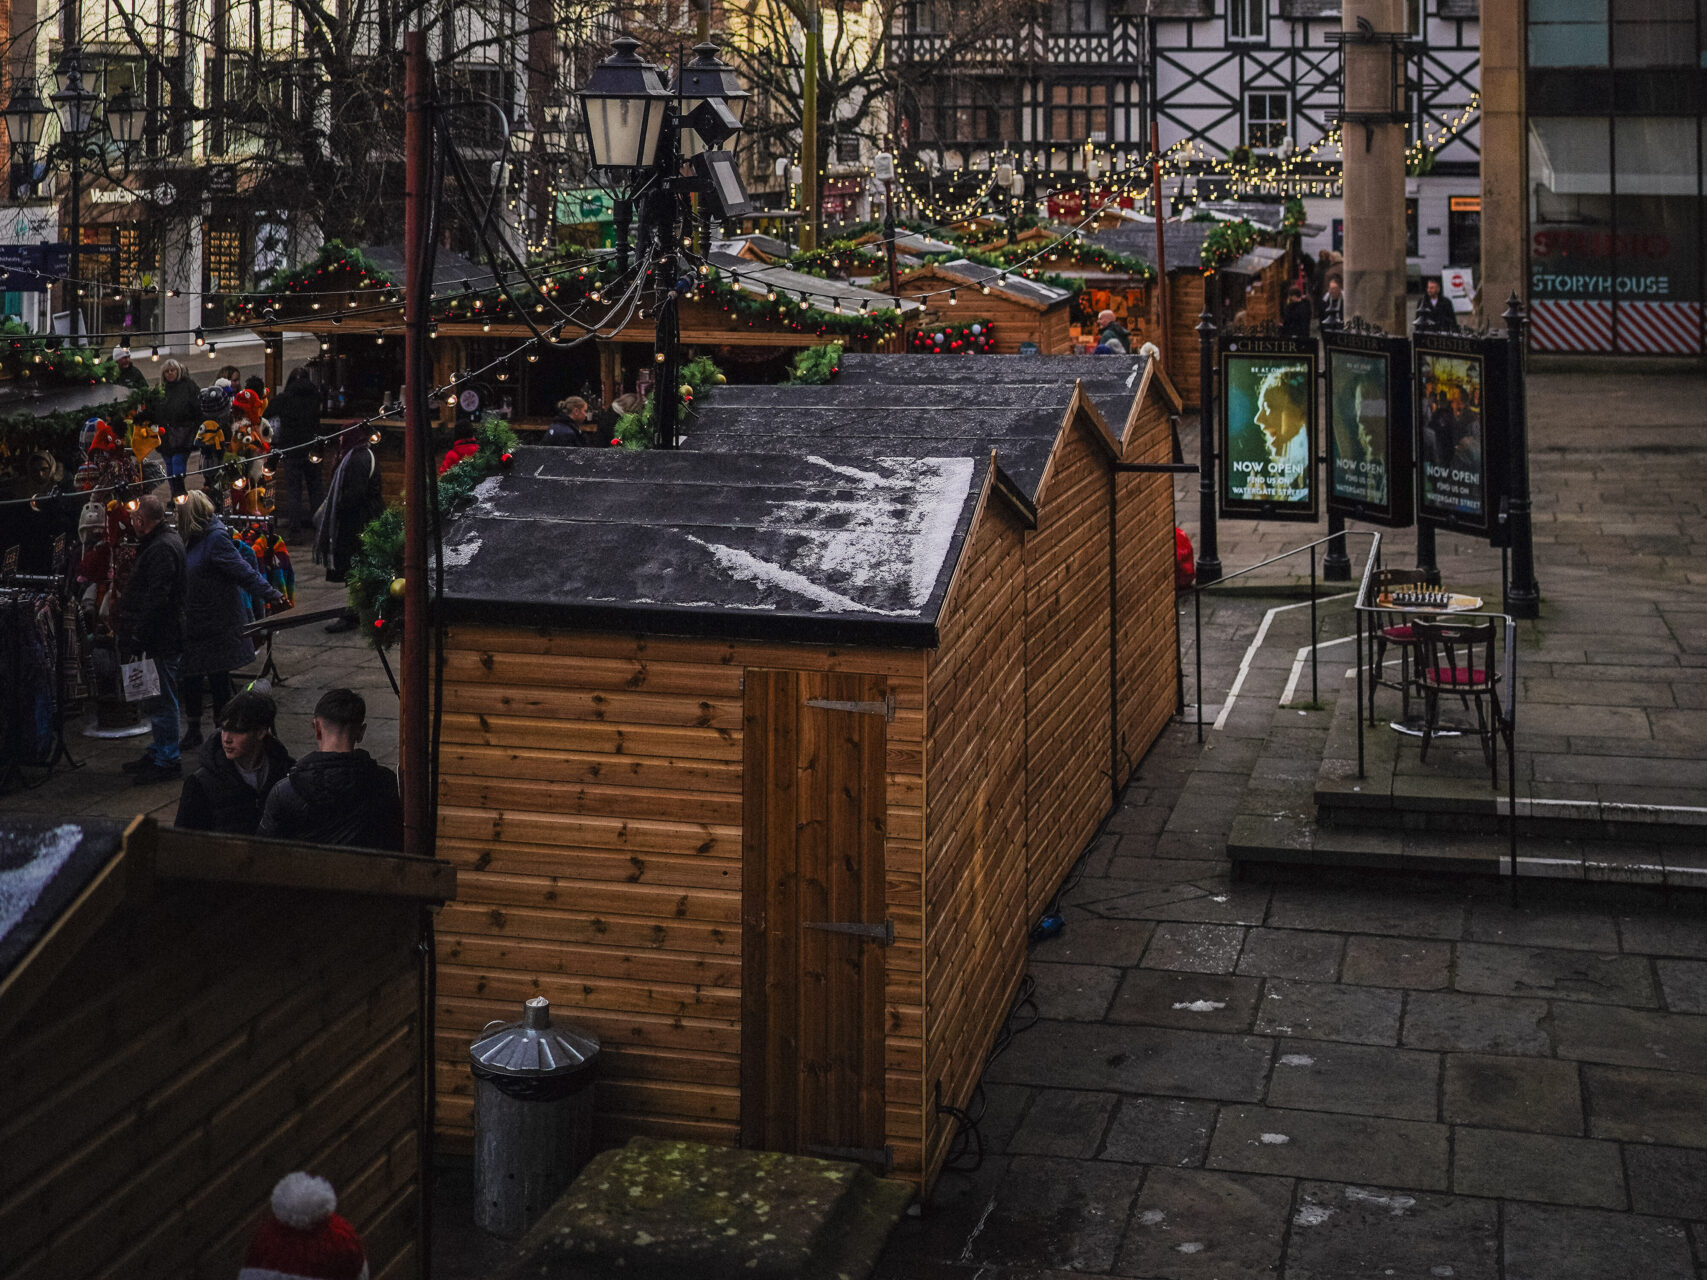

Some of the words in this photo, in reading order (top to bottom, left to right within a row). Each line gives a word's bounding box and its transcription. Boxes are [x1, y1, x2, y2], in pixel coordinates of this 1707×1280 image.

[1533, 230, 1668, 256] STUDIO
[1532, 274, 1669, 294] STORYHOUSE
[1238, 340, 1296, 352] CHESTER
[1233, 461, 1263, 472] NOW
[1268, 463, 1303, 474] OPEN!
[1336, 459, 1357, 470] NOW
[1427, 465, 1449, 478] NOW
[1452, 470, 1479, 485] OPEN!
[1232, 487, 1276, 495] WATERGATE
